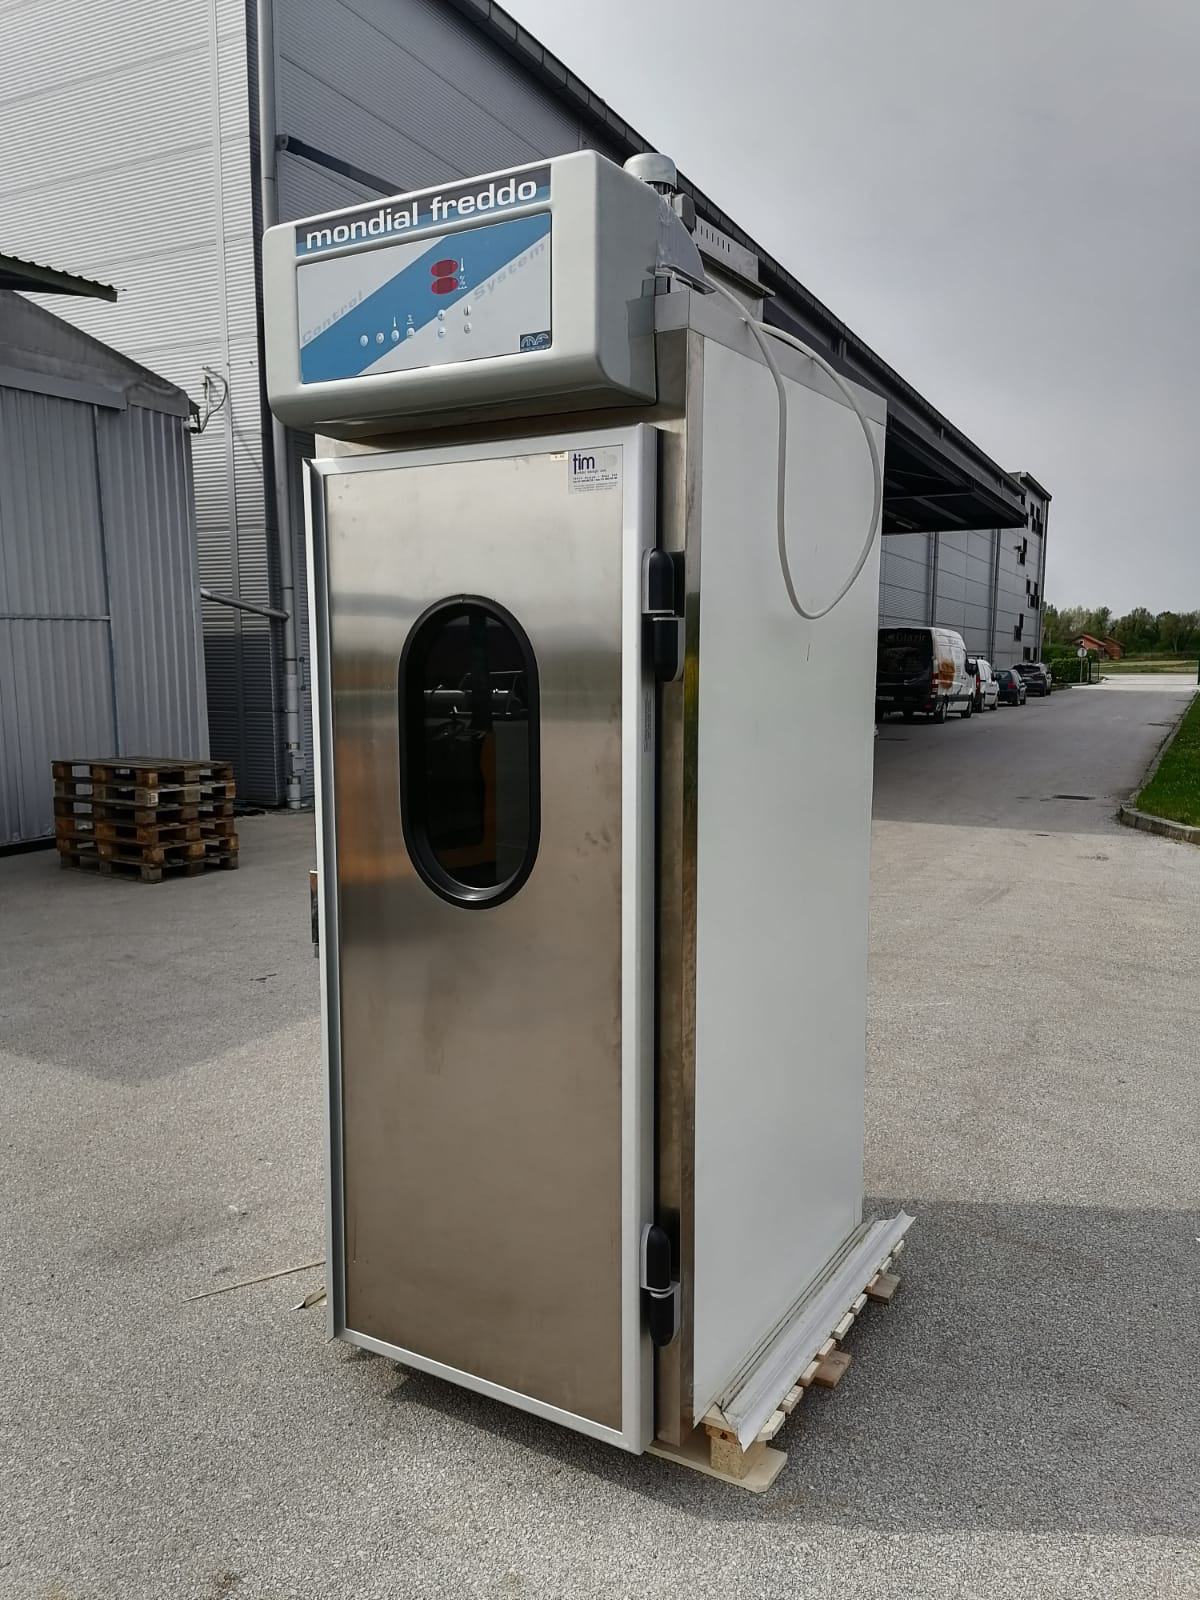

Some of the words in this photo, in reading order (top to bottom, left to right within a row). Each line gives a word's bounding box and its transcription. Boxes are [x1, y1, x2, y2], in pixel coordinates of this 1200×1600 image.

[306, 201, 418, 249] mondial
[430, 178, 537, 221] freddo
[473, 244, 545, 300] System
[303, 289, 362, 342] Control
[572, 453, 595, 475] tim
